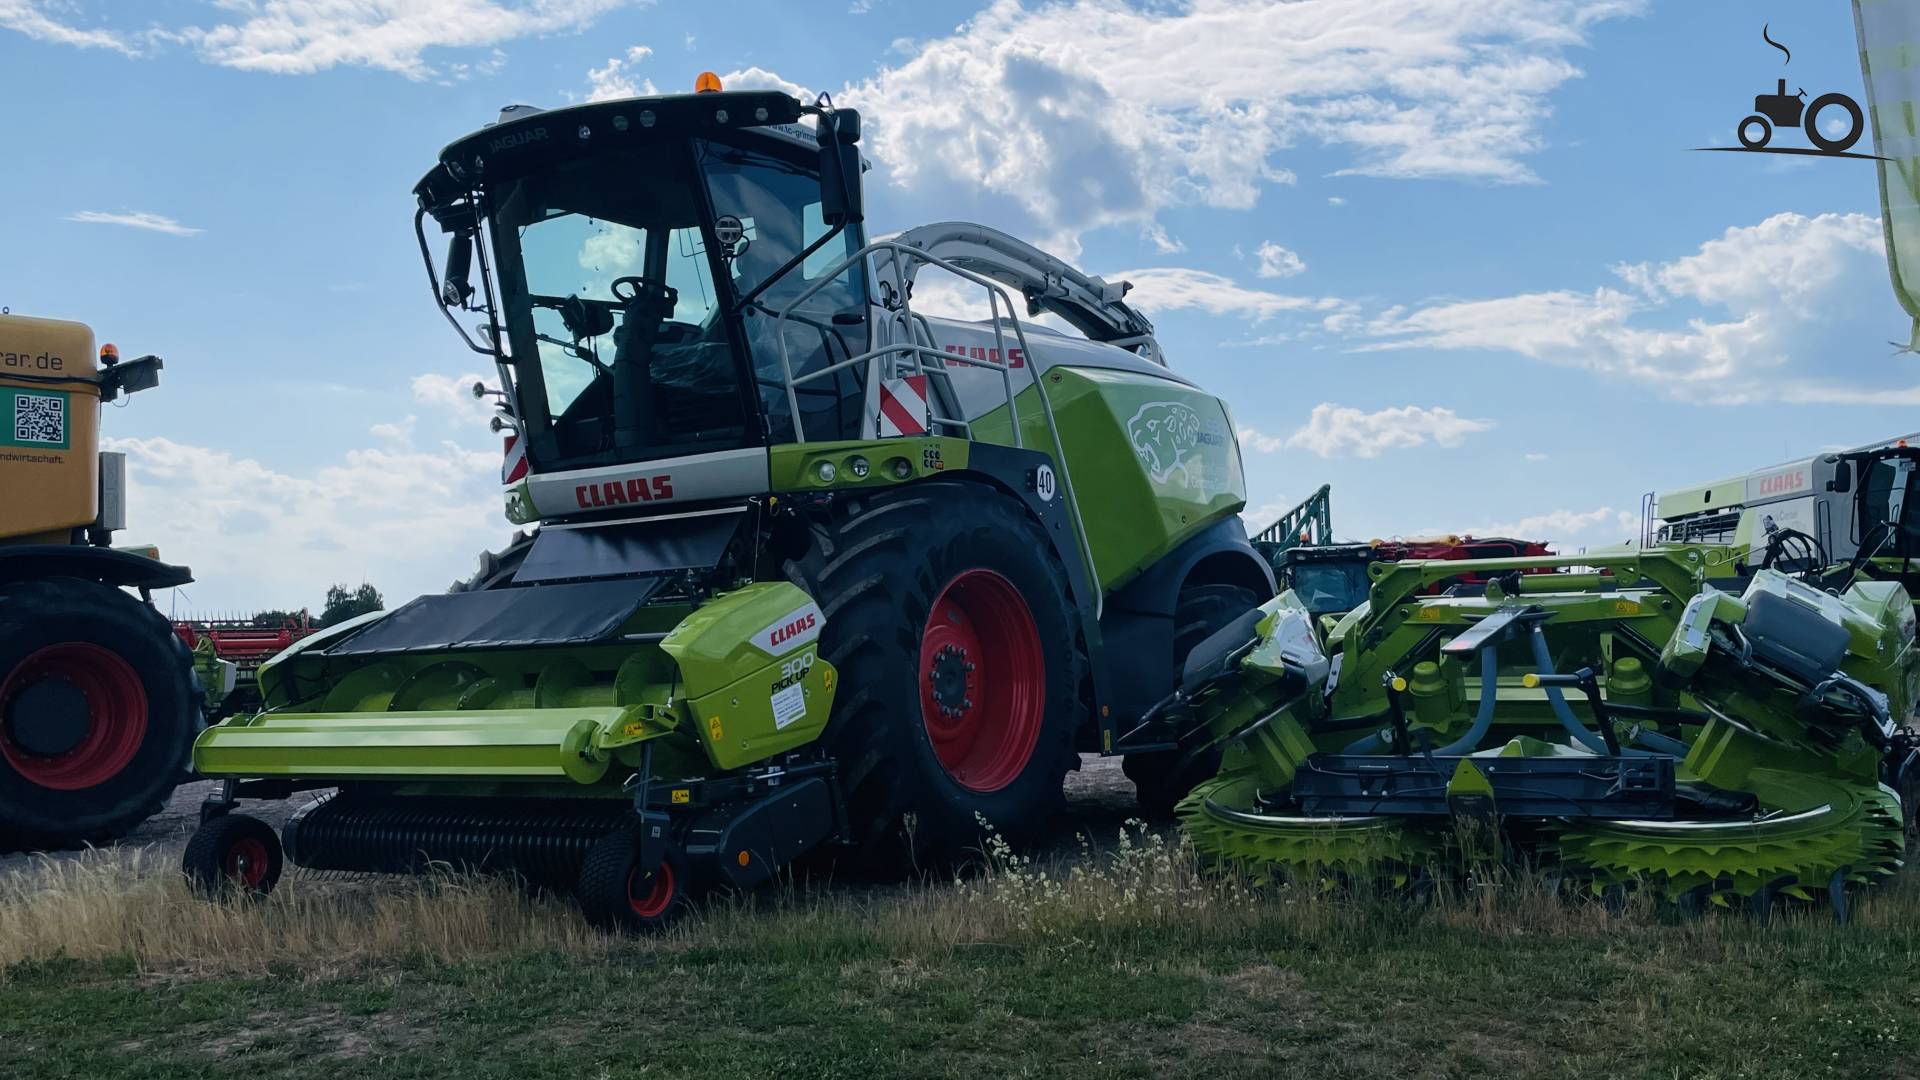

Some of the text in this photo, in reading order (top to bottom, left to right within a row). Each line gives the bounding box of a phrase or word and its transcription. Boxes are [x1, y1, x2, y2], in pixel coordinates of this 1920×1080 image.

[488, 127, 549, 154] JAGUAR
[576, 475, 673, 508] CLAAS
[1039, 470, 1052, 494] 40
[1760, 472, 1804, 495] CLAAS
[770, 613, 816, 647] CLAAS
[781, 652, 814, 679] 300
[771, 667, 810, 695] PICK UP
